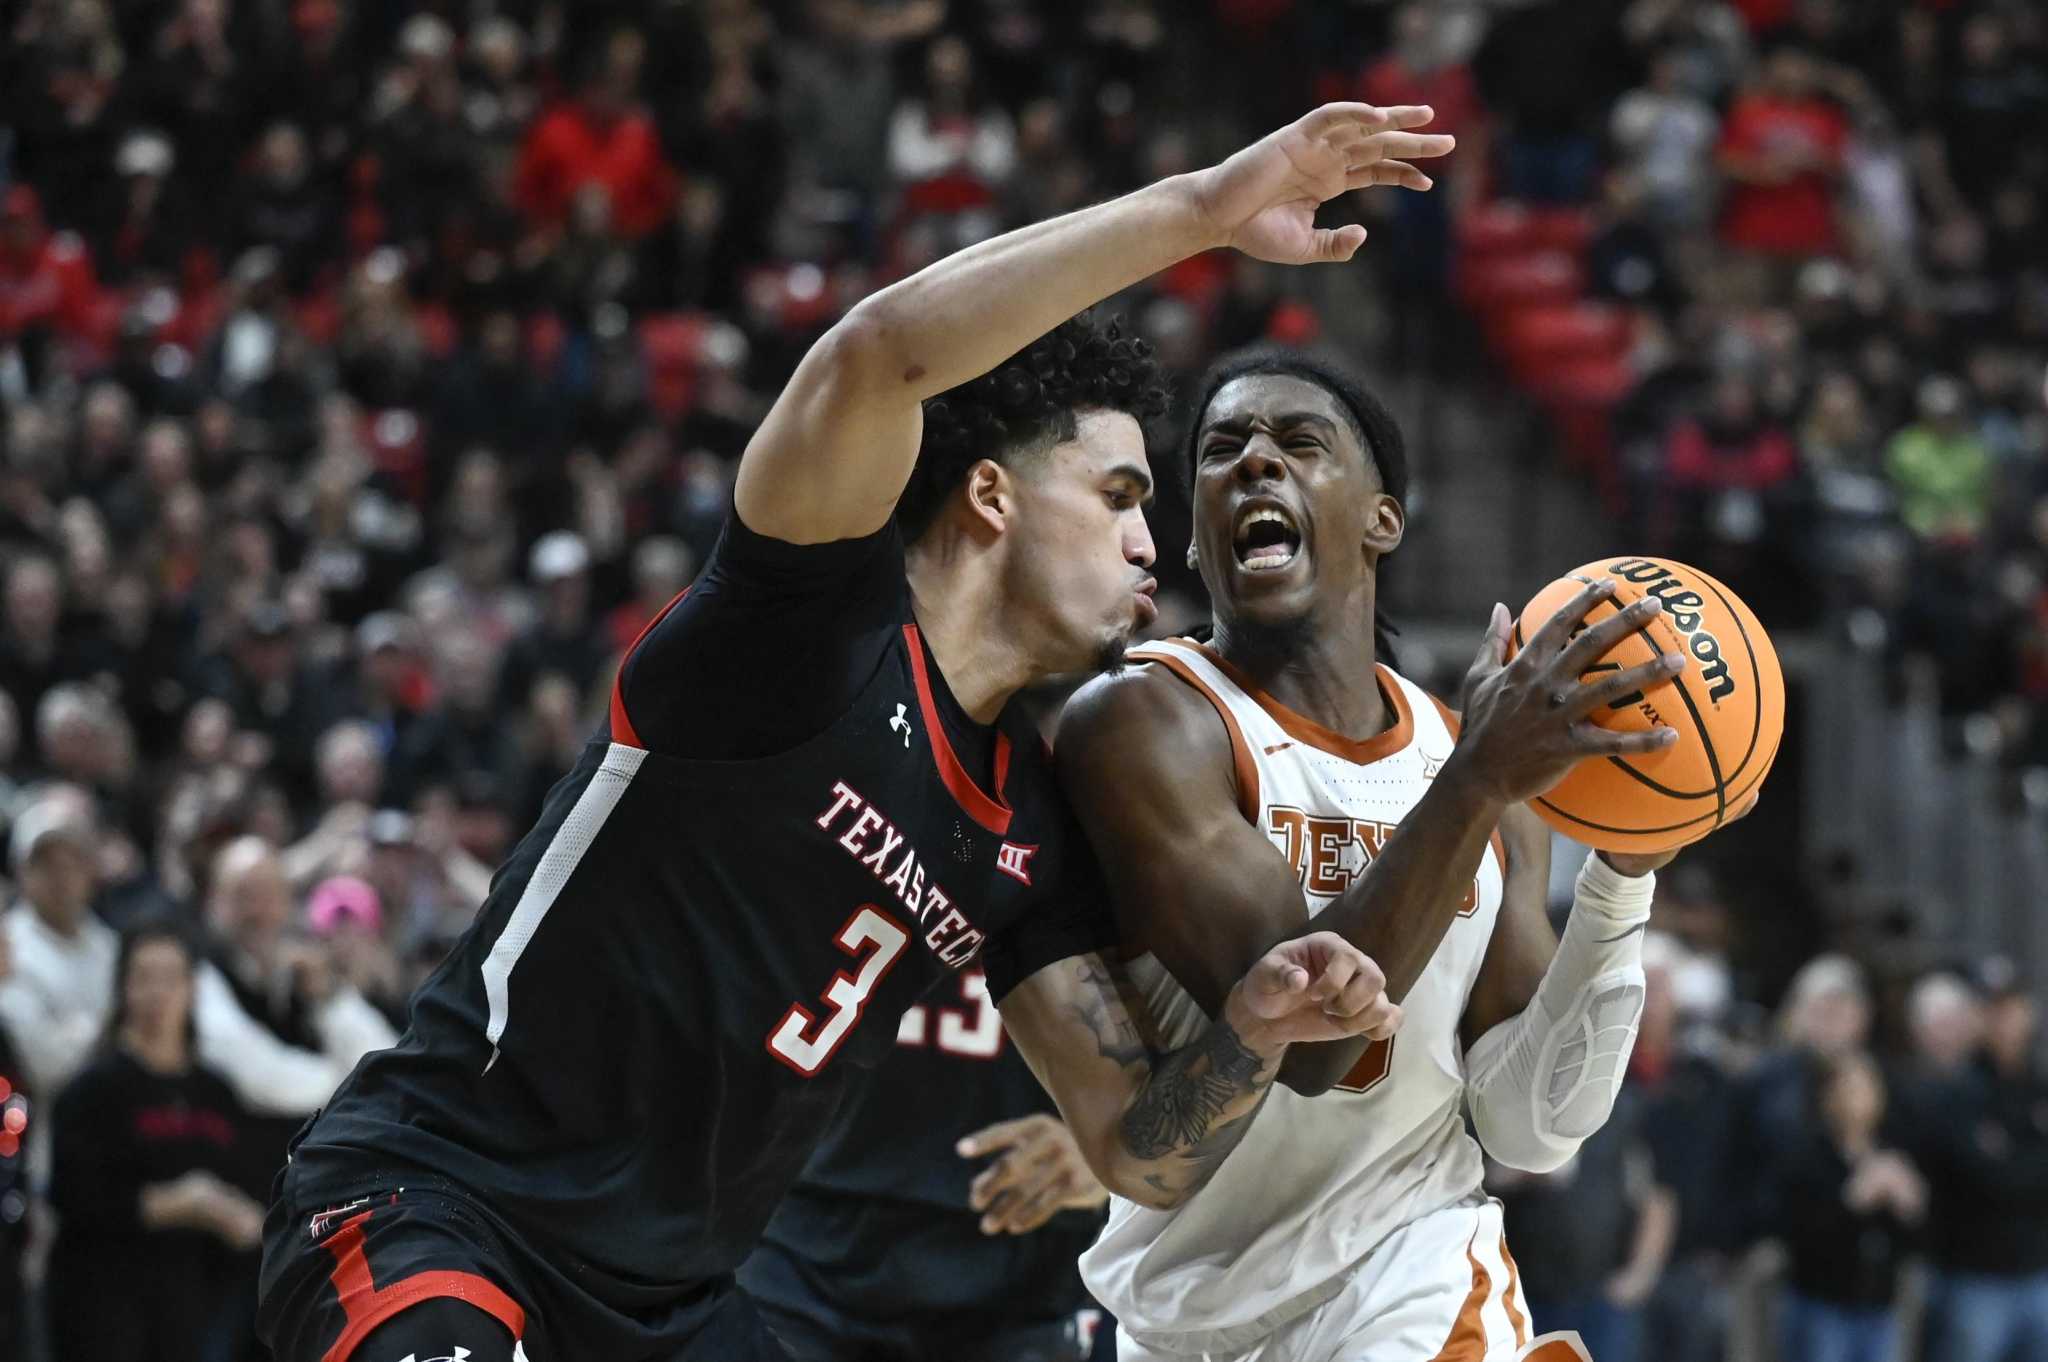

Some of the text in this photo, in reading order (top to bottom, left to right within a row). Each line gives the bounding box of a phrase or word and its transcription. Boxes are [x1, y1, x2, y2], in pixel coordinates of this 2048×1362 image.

[1639, 702, 1669, 727] NX
[817, 780, 926, 914] TEXAS
[767, 903, 912, 1078] 3
